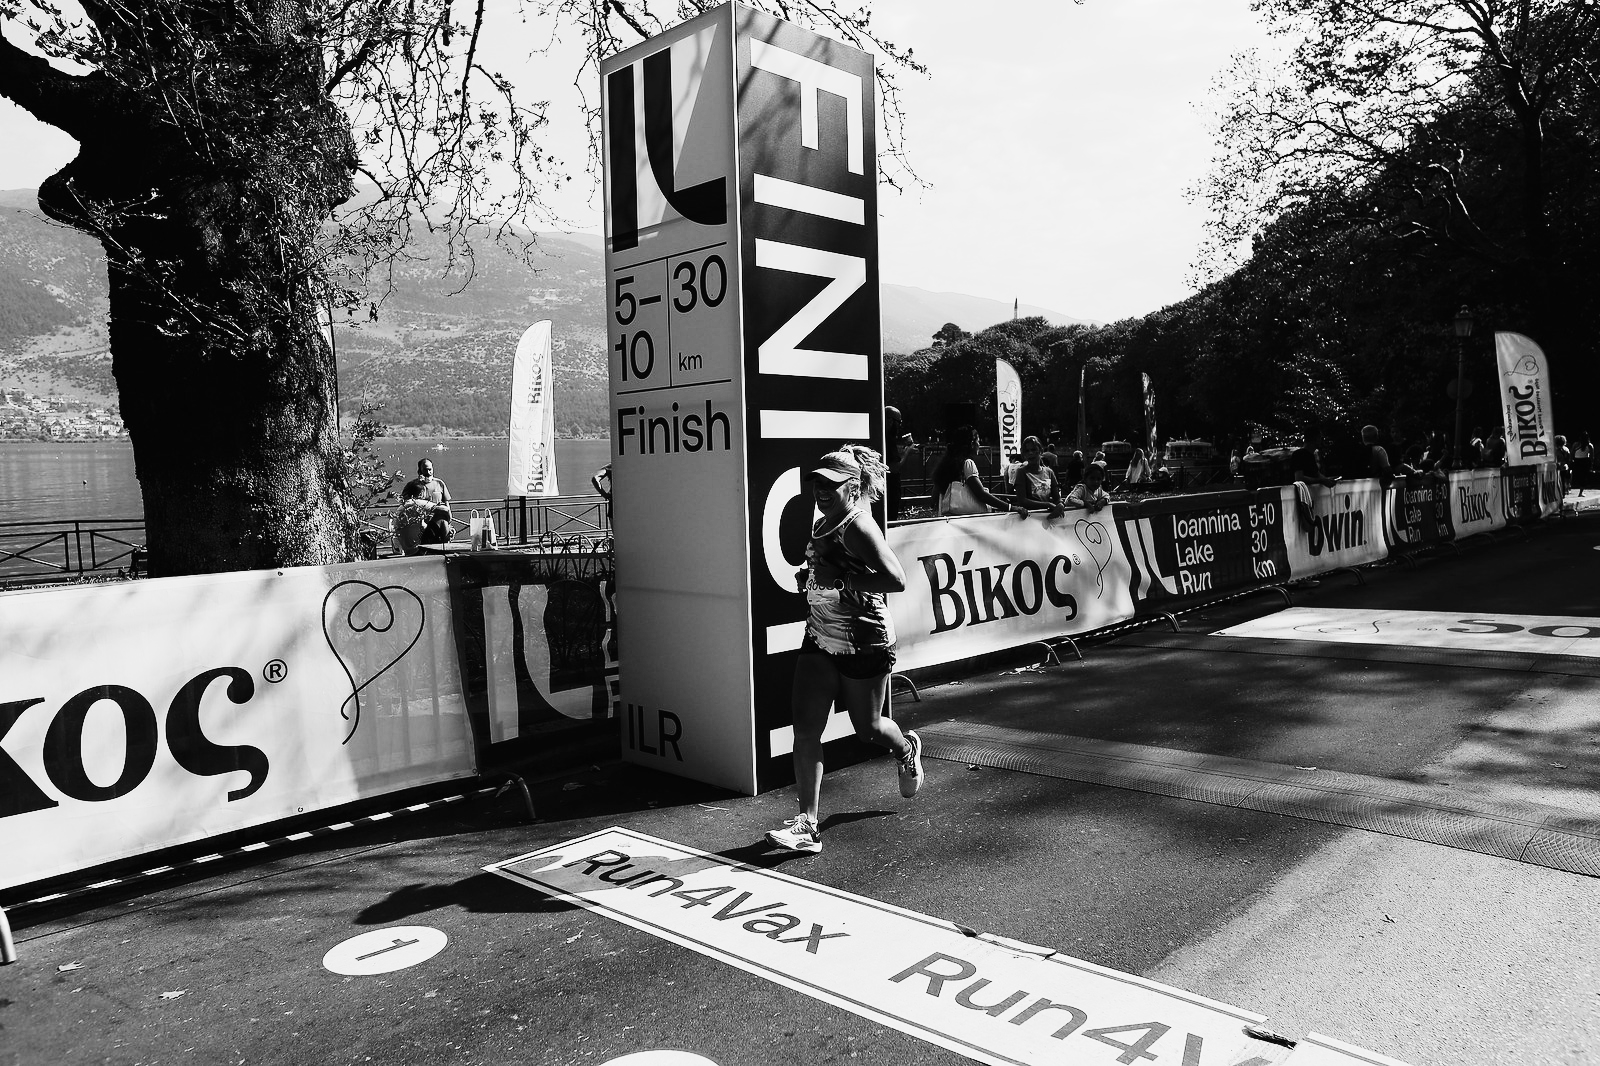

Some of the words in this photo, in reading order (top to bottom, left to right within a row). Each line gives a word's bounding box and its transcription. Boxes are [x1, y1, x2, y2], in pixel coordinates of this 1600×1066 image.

[672, 254, 728, 314] 30
[614, 330, 655, 382] 10
[678, 352, 703, 372] km
[617, 399, 732, 456] Finish
[1172, 509, 1241, 539] Ioannina
[1248, 503, 1275, 528] 5-10
[1175, 540, 1214, 567] Lake
[1251, 529, 1268, 554] 30
[1179, 570, 1213, 595] Run
[1252, 557, 1277, 579] km
[917, 550, 1078, 635] Βίκος
[628, 703, 684, 763] ILR
[562, 849, 851, 954] Run4Vax
